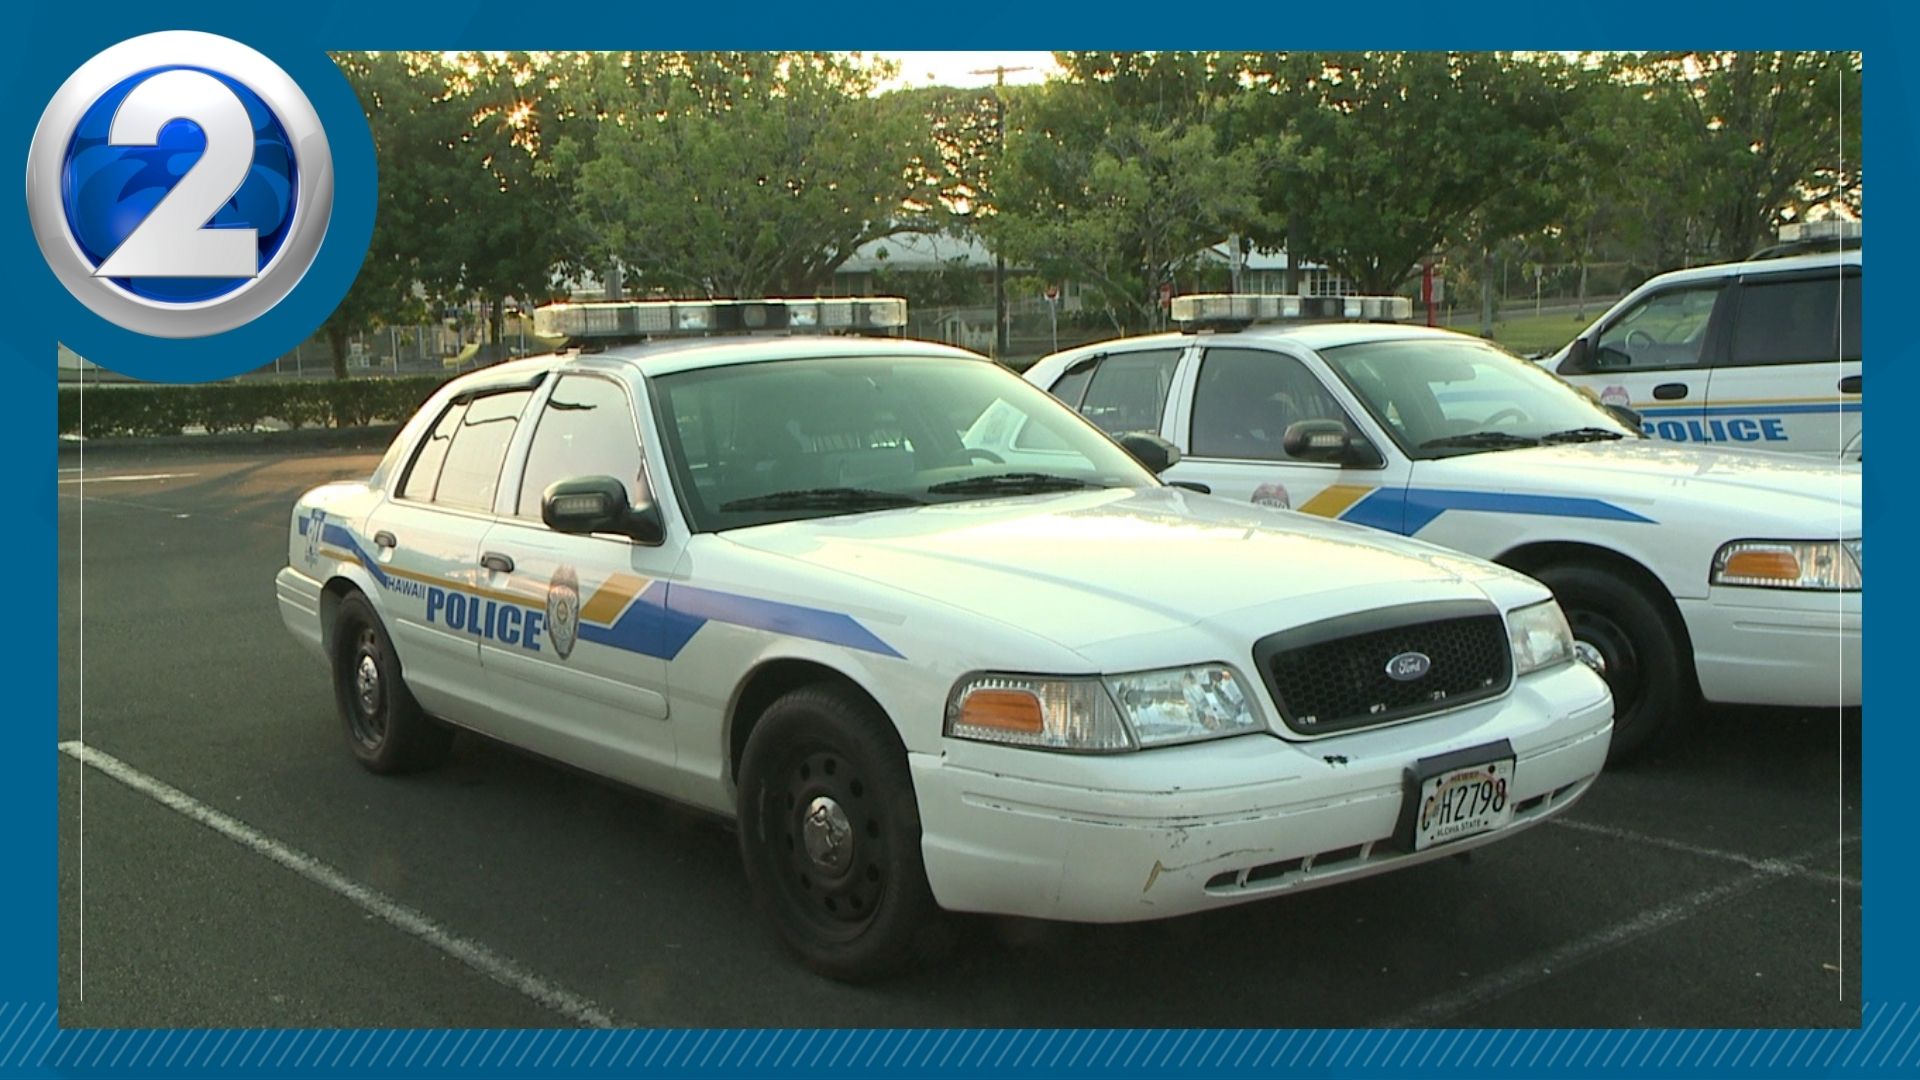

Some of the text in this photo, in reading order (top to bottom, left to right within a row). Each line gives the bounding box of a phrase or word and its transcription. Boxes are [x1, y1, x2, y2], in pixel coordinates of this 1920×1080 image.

[386, 575, 426, 600] HAWAII
[426, 586, 542, 652] POLICE
[1399, 657, 1421, 675] Ford
